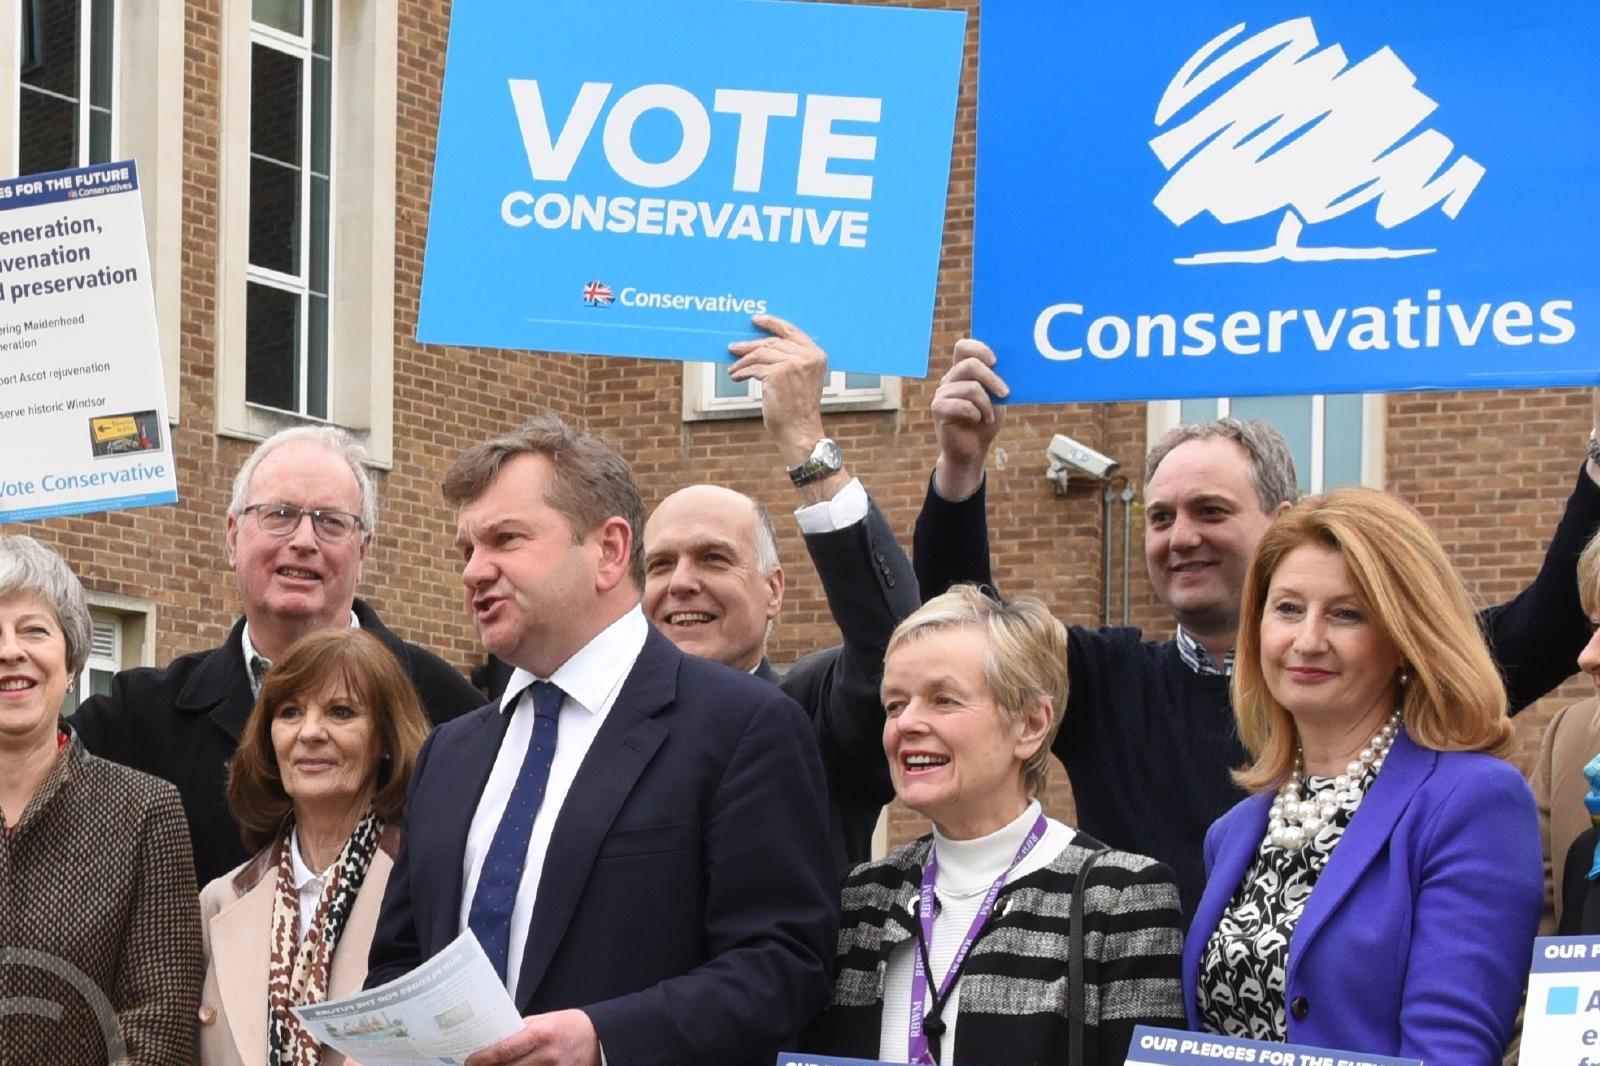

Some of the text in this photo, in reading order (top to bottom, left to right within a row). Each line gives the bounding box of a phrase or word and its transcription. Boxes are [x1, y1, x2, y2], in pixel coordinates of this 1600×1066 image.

[508, 79, 882, 200] VOTE
[501, 191, 869, 248] CONSERVATIVE
[10, 265, 138, 305] preservation
[620, 287, 767, 315] Conservatives
[1033, 290, 1576, 361] Conservatives
[19, 370, 47, 383] Ascot
[49, 362, 111, 380] rejuvenation
[41, 463, 165, 492] Conservative
[920, 884, 933, 918] RBWM
[1544, 944, 1587, 959] OUR
[910, 1001, 923, 1038] RBWM
[1140, 1035, 1178, 1052] OUR
[1180, 1039, 1257, 1063] PLEDGES
[1258, 1049, 1296, 1066] FOR
